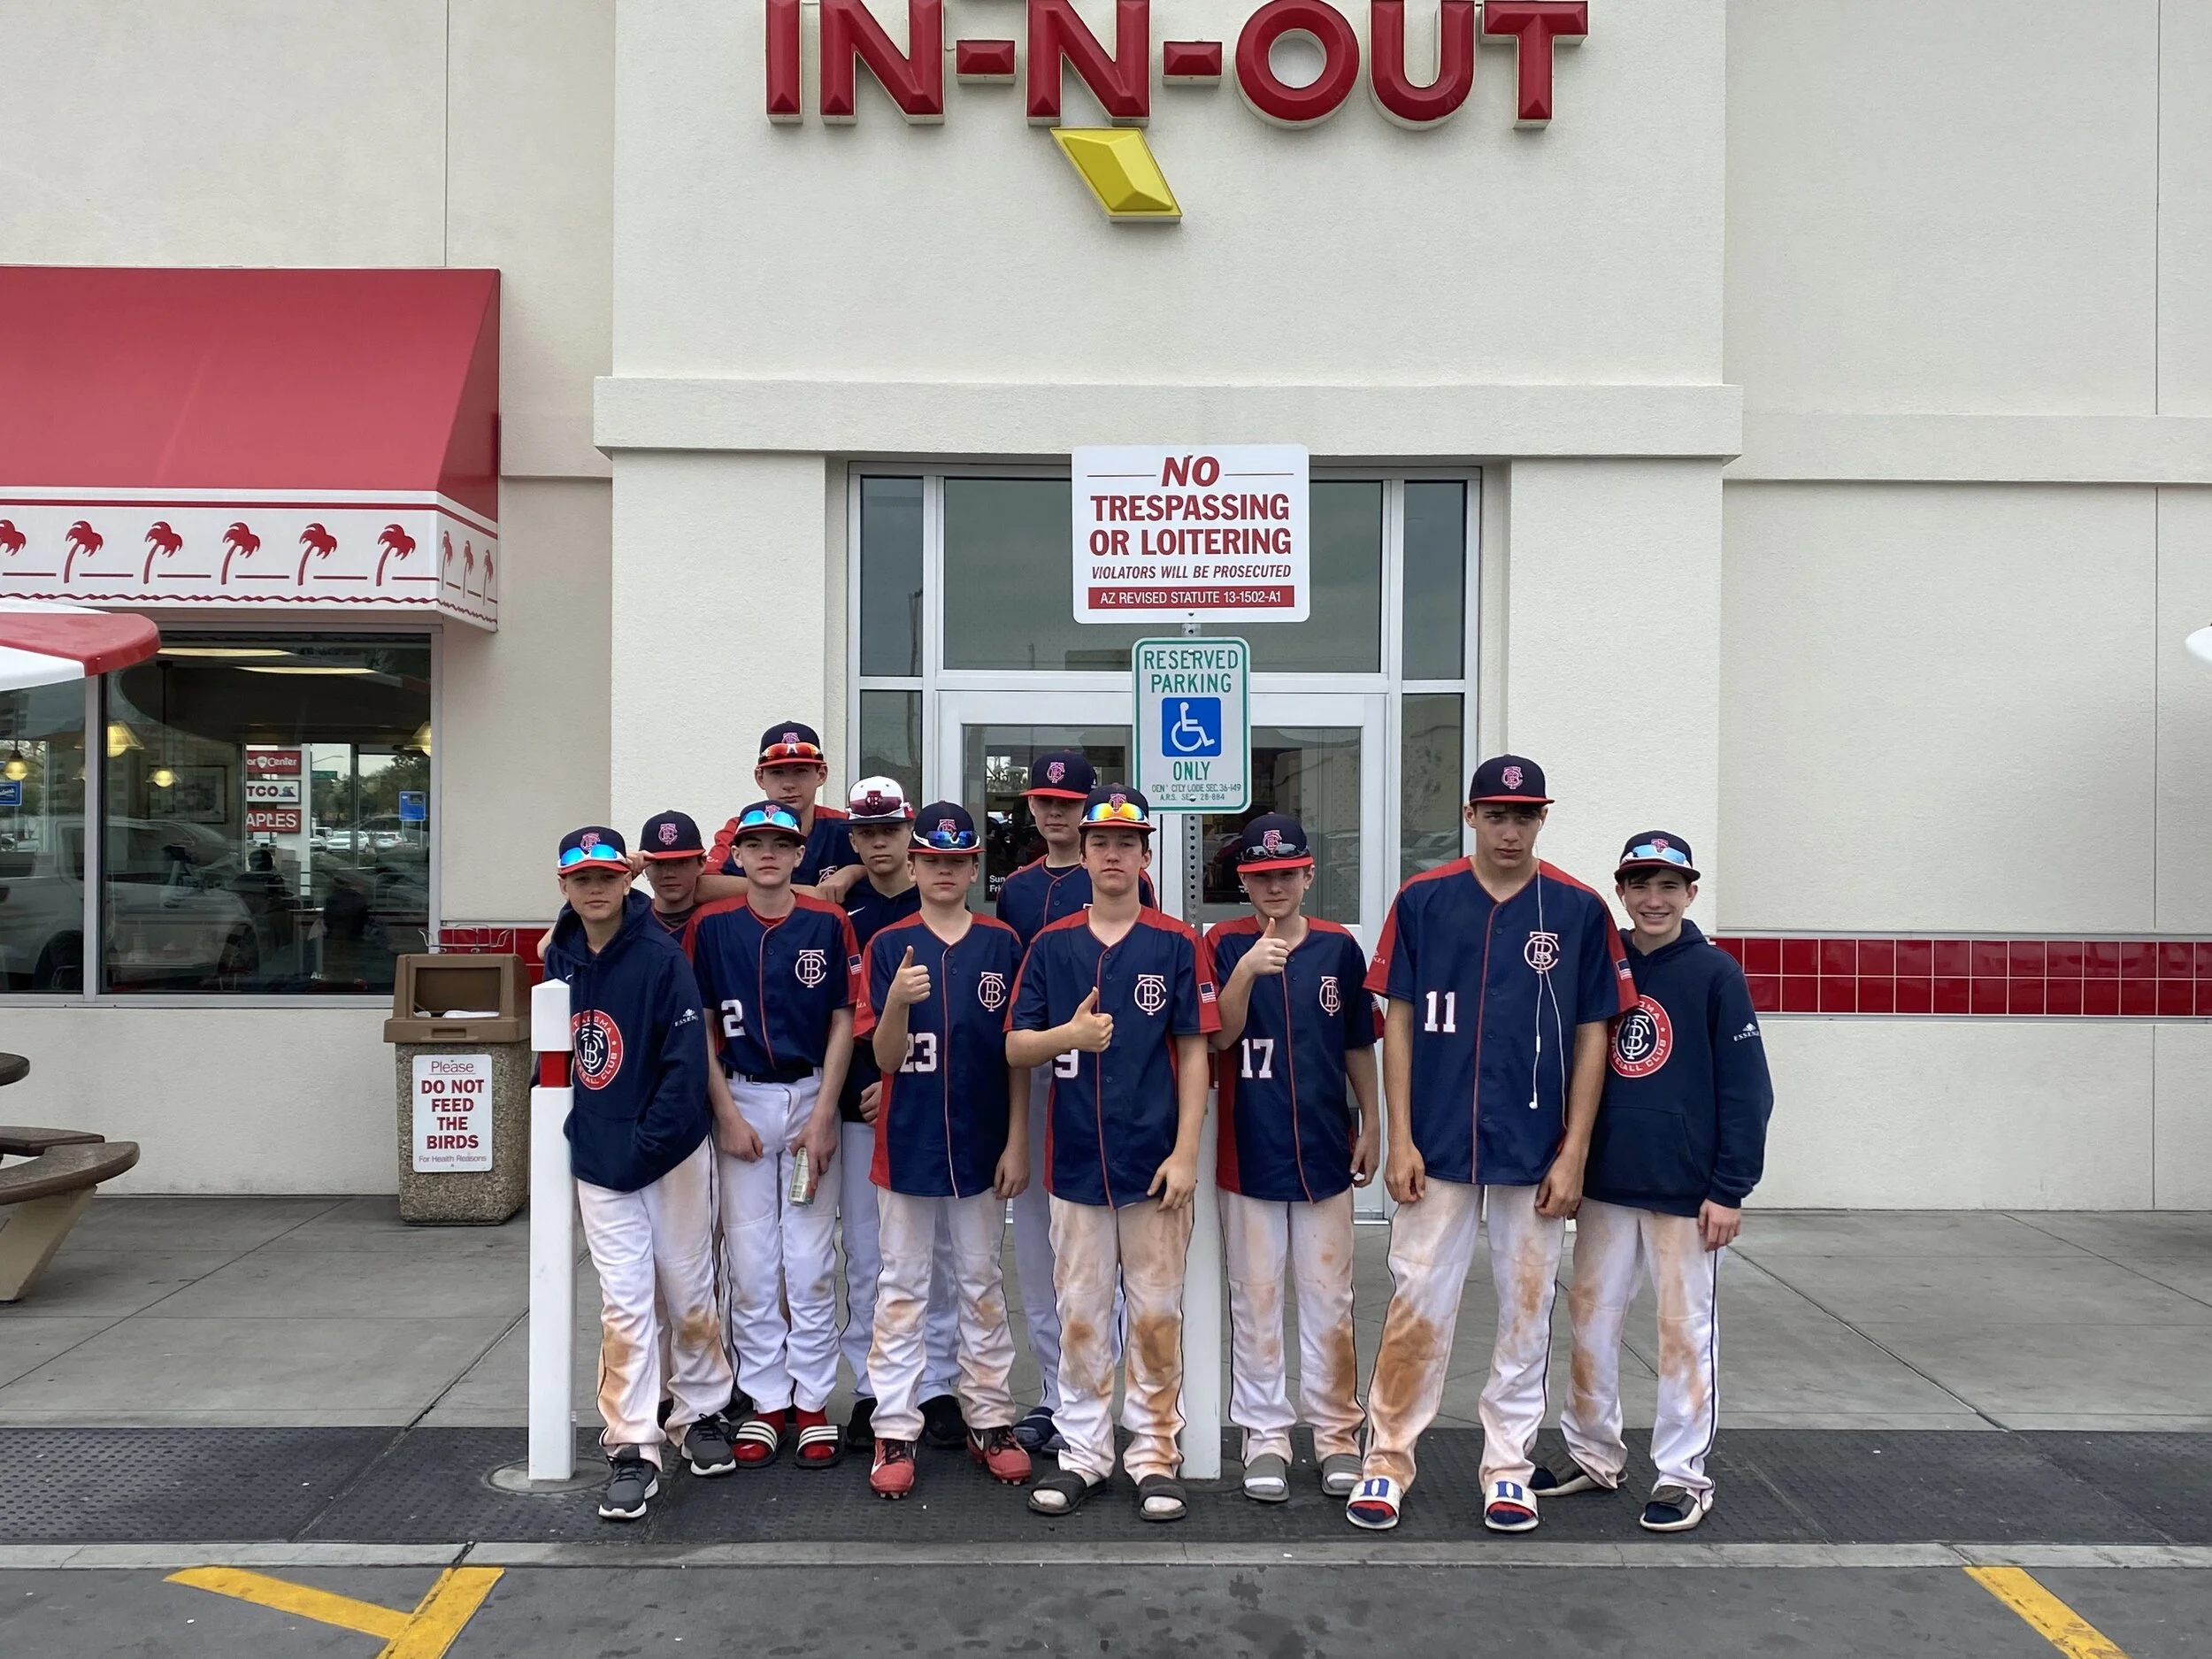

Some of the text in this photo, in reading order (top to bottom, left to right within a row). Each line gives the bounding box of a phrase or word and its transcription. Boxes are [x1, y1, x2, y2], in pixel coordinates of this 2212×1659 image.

[765, 0, 1589, 129] IN-N-OUT
[1161, 456, 1220, 487] NO
[1090, 493, 1289, 521] TRESPASSING
[1089, 527, 1291, 556] OR LOITERING
[1092, 565, 1291, 580] VIOLATORS WILL BE PROSECUTED
[1100, 590, 1281, 604] AZ REVISED STATUTE 13-1502-A1
[1144, 649, 1239, 670] RESERVED
[1151, 673, 1232, 693] PARKING
[267, 757, 297, 767] Center
[1173, 761, 1210, 781] ONLY
[721, 999, 746, 1038] 2
[1425, 990, 1455, 1033] 11
[431, 1061, 474, 1073] Please
[1240, 1038, 1275, 1079] 17
[421, 1079, 484, 1094] DO NOT
[432, 1098, 474, 1112] FEED
[437, 1117, 468, 1131] THE
[426, 1134, 479, 1149] BIRDS
